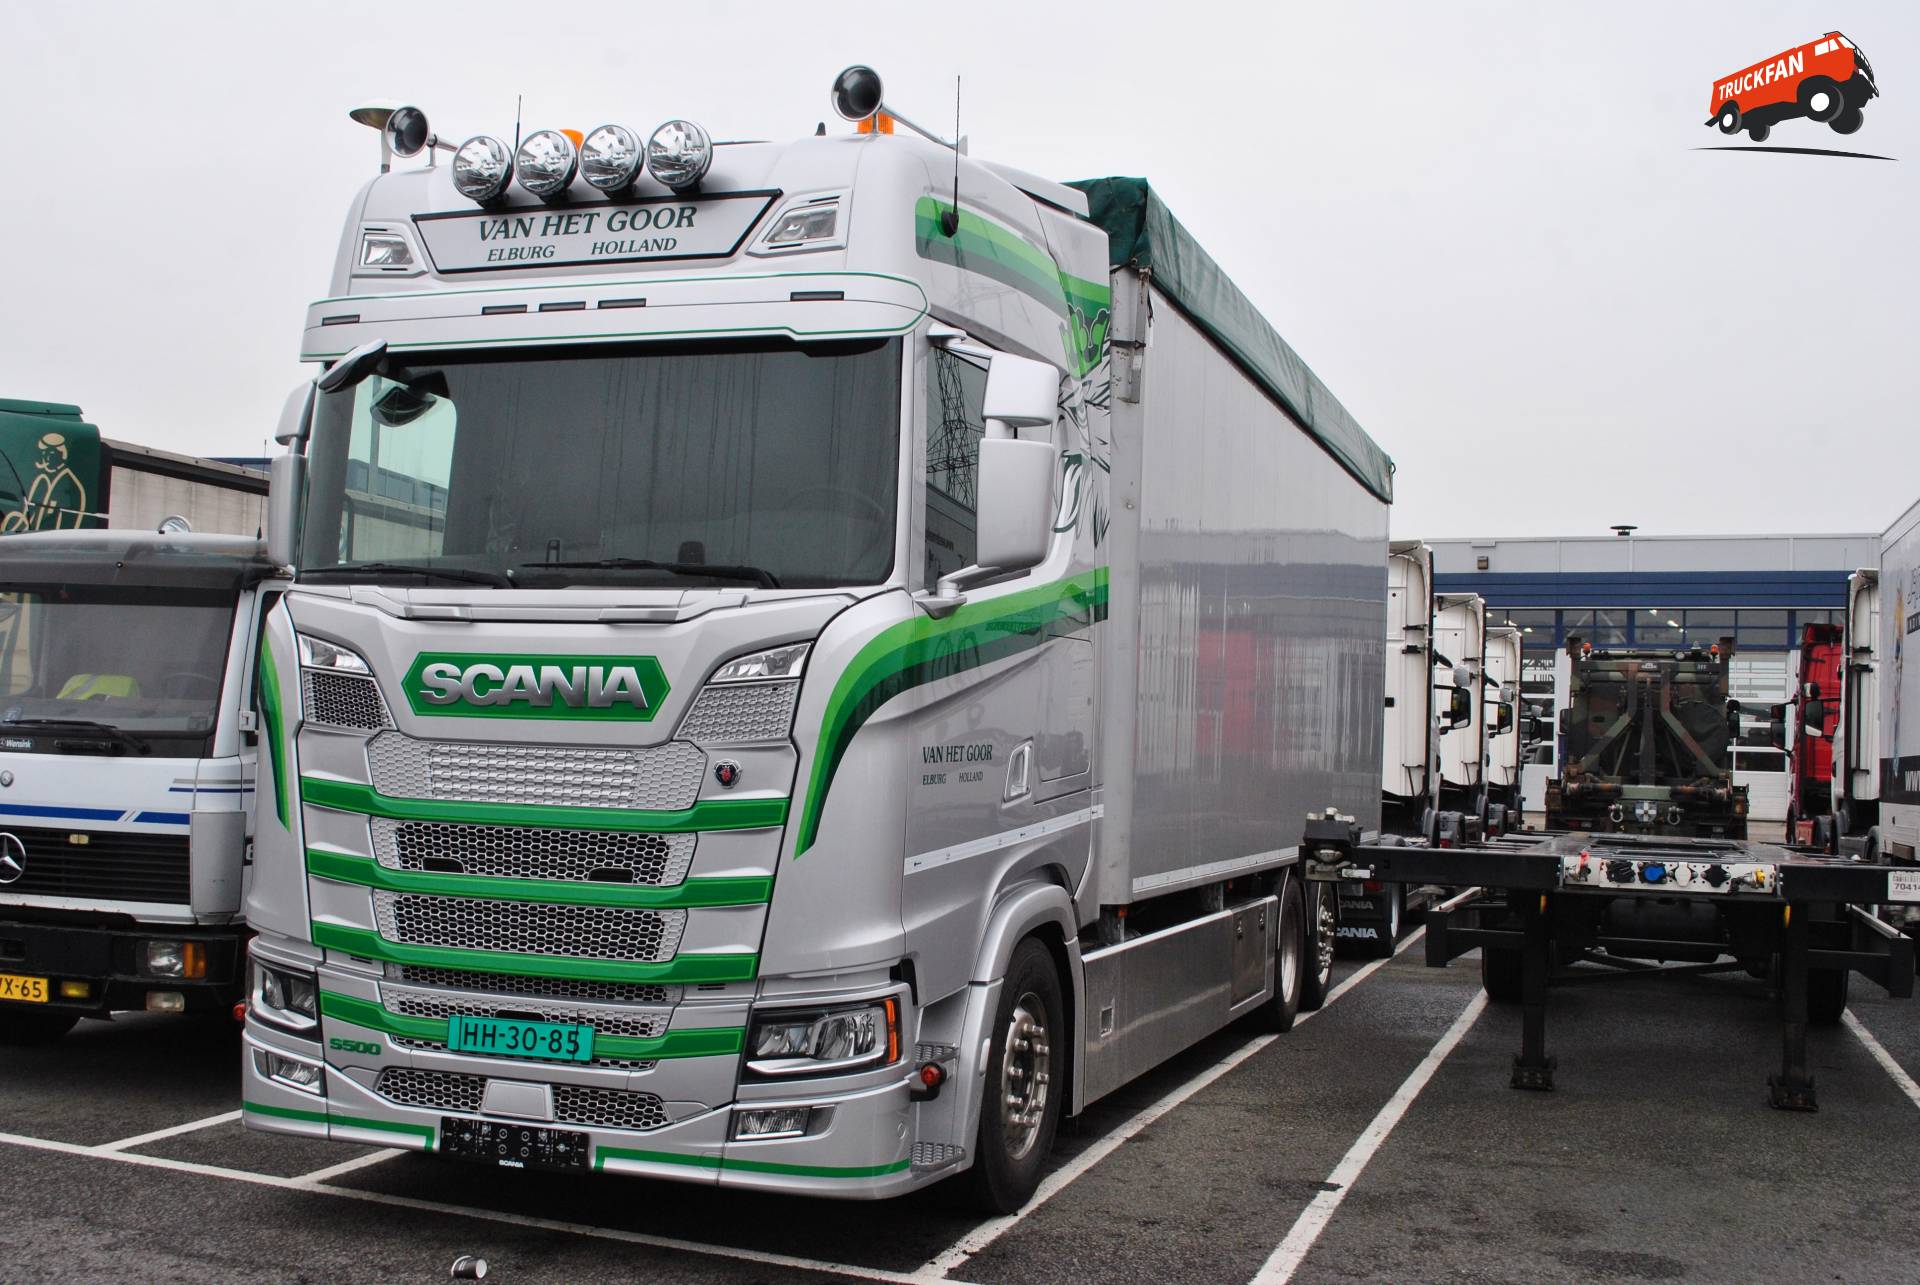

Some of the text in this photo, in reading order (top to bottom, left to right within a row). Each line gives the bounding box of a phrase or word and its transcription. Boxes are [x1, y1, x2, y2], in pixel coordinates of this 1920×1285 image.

[479, 206, 697, 241] VAN HET GOOR
[487, 238, 677, 262] ELBURG HOLLAND
[419, 662, 649, 708] SCANIA
[922, 744, 993, 764] VAN HET GOOR
[922, 771, 984, 785] ELBURG HOLLAND
[329, 1038, 381, 1056] S500
[464, 1022, 580, 1055] HH-30-85
